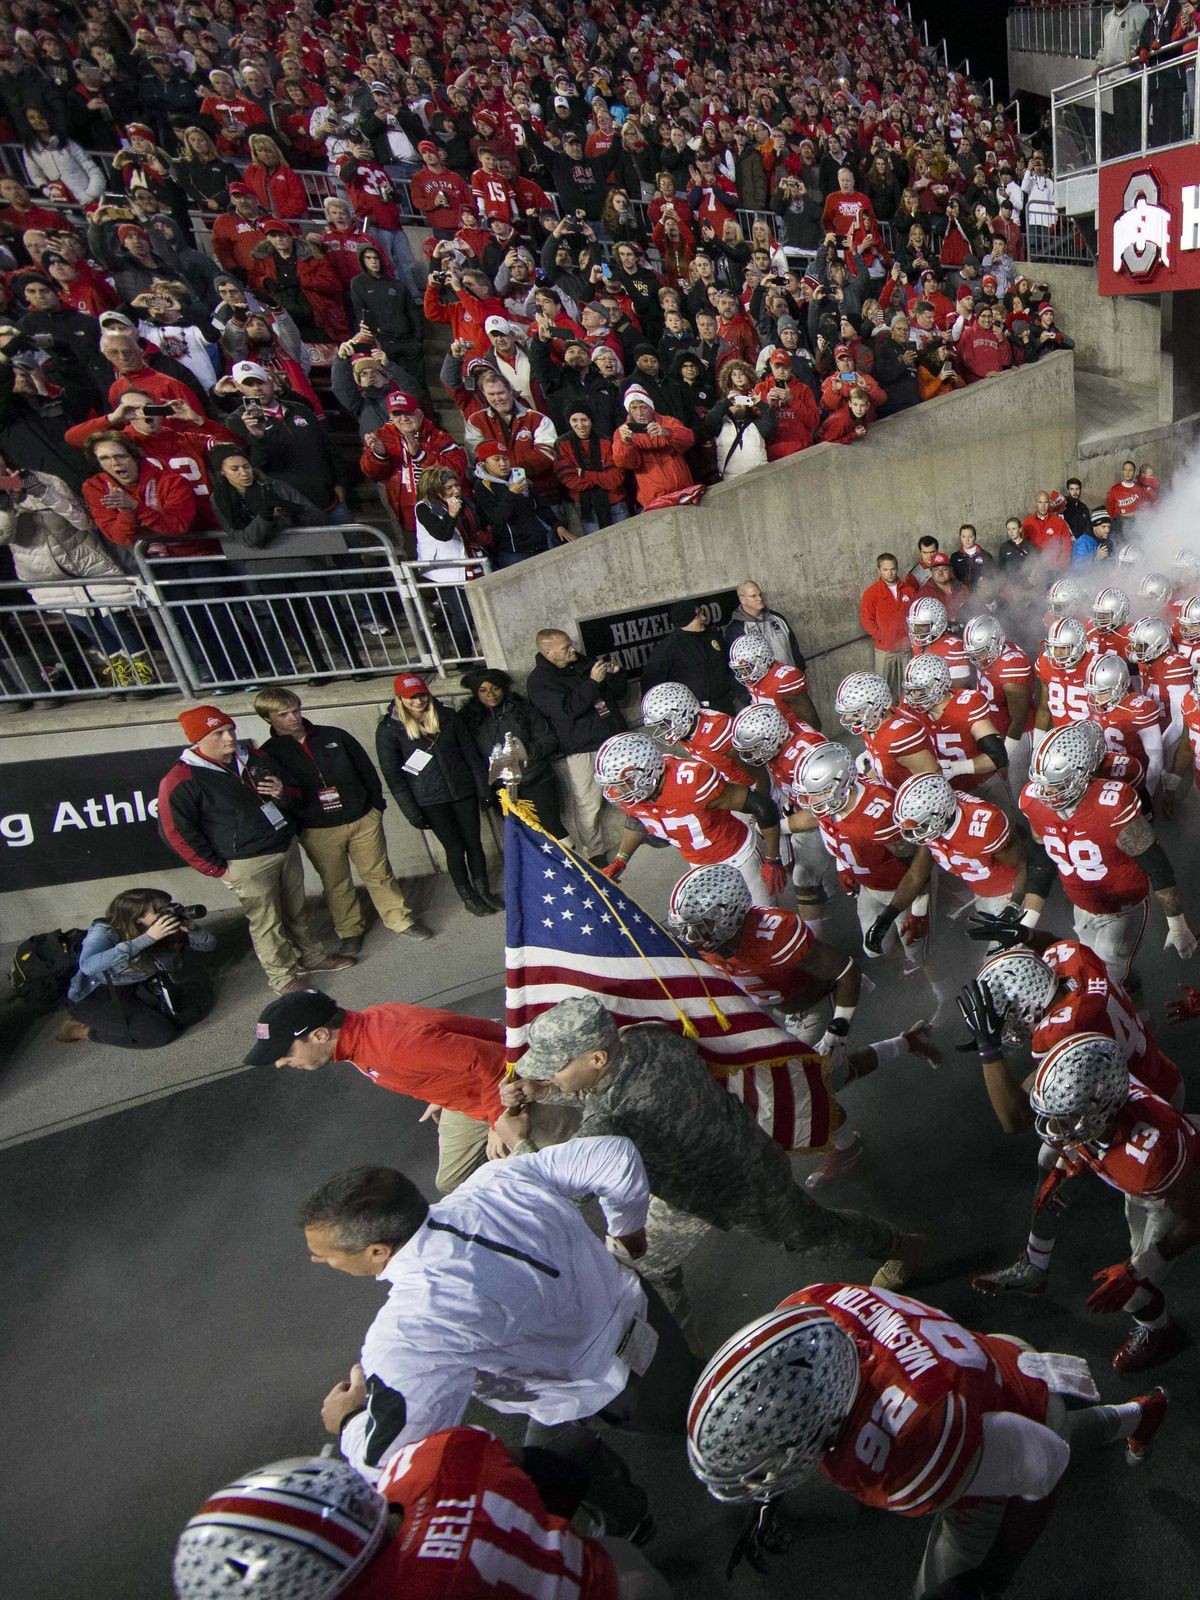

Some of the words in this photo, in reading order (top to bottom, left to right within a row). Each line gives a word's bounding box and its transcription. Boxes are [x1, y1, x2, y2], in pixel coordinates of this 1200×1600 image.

[487, 182, 506, 202] 15
[1047, 682, 1091, 721] 85
[863, 797, 892, 819] 51
[968, 808, 993, 838] 23
[1043, 835, 1110, 883] 68
[755, 913, 783, 941] 15
[1125, 1121, 1161, 1165] 13
[826, 1286, 939, 1381] WASHINGTON
[855, 1385, 919, 1473] 92
[417, 1494, 477, 1560] BELL
